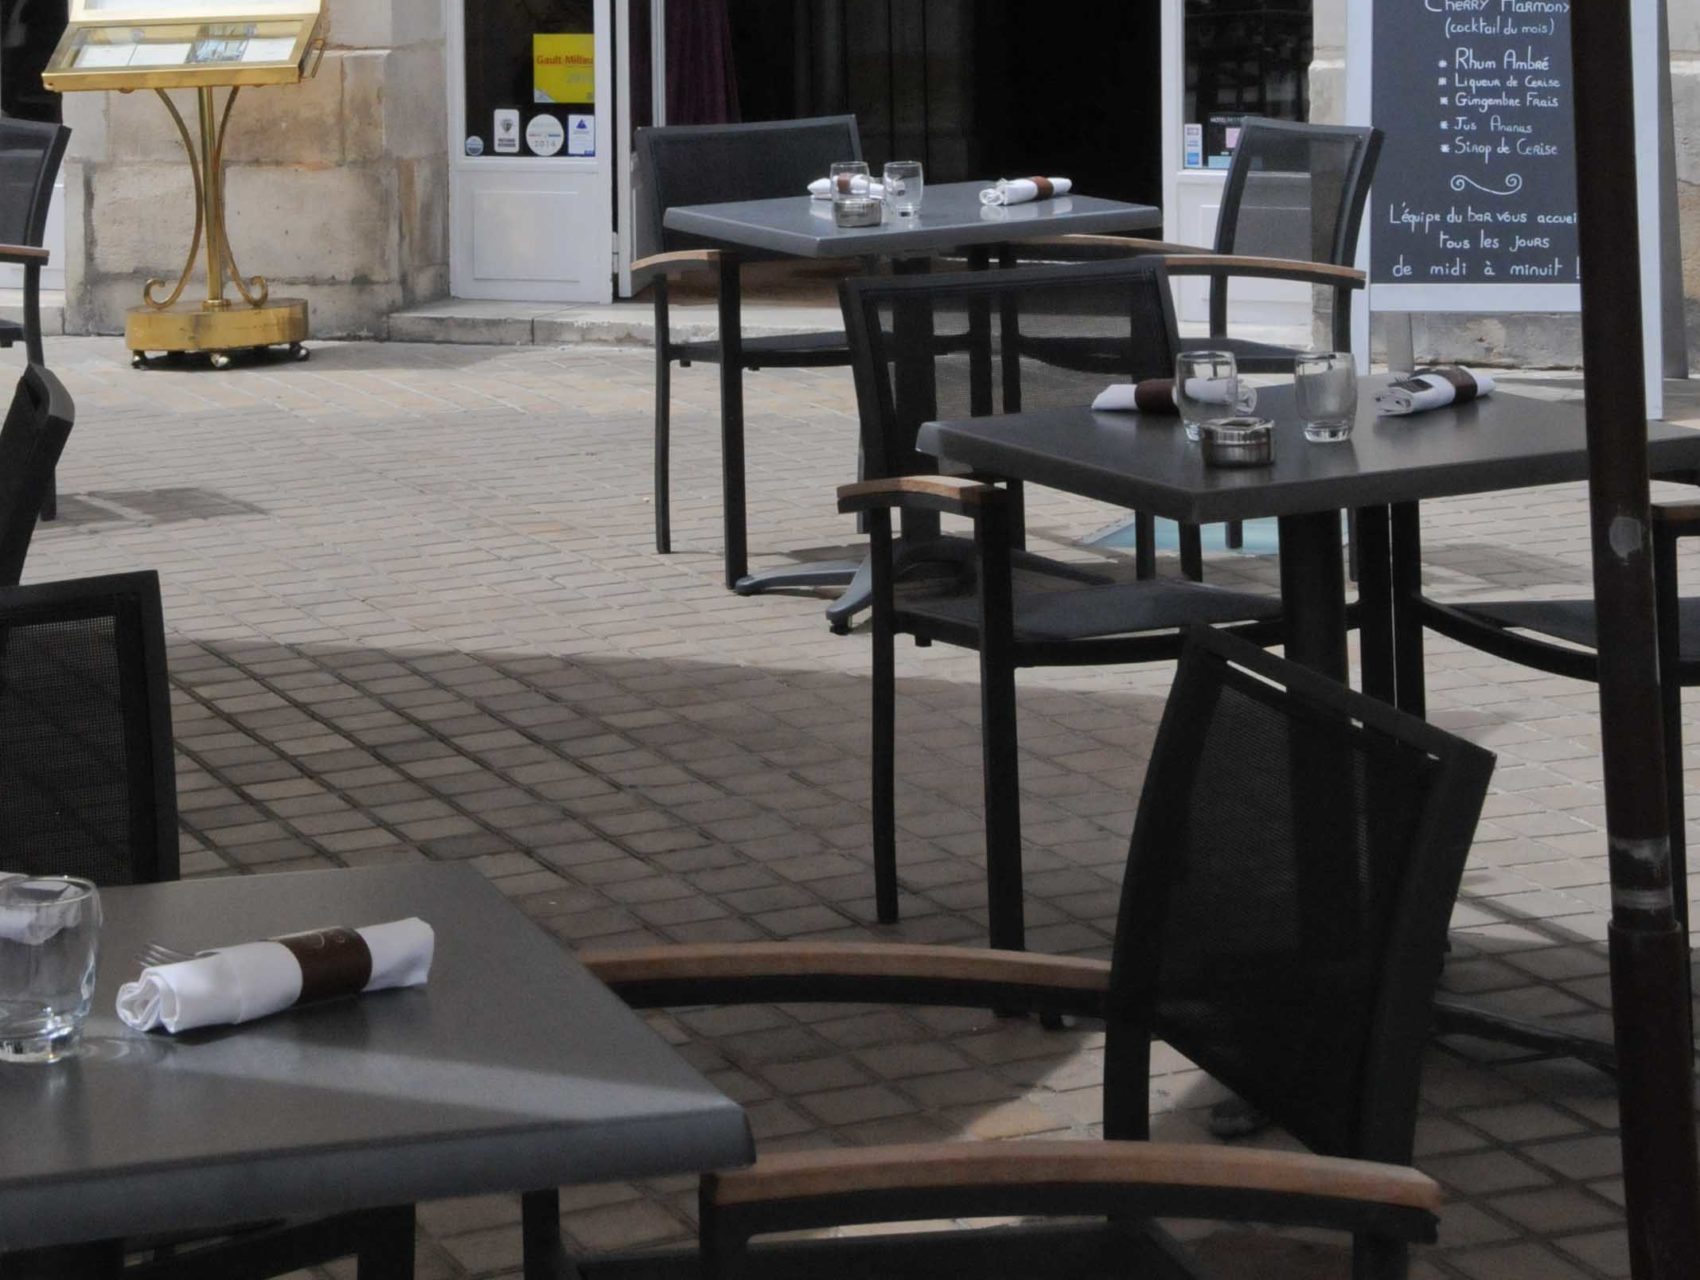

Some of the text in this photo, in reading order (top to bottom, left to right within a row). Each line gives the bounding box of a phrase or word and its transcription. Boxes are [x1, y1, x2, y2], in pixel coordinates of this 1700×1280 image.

[1445, 16, 1555, 38] (cocktail du mois)
[1455, 47, 1496, 69] Rhum
[1506, 75, 1518, 87] de
[1454, 114, 1533, 133] Jus Ananas
[1496, 137, 1511, 154] de
[1447, 206, 1462, 224] du
[1496, 211, 1528, 224] vous
[1440, 230, 1471, 249] tous
[1480, 229, 1500, 249] les
[1392, 254, 1412, 277] de
[1430, 257, 1467, 276] midi
[1484, 261, 1495, 276] à
[1510, 257, 1563, 277] minuit
